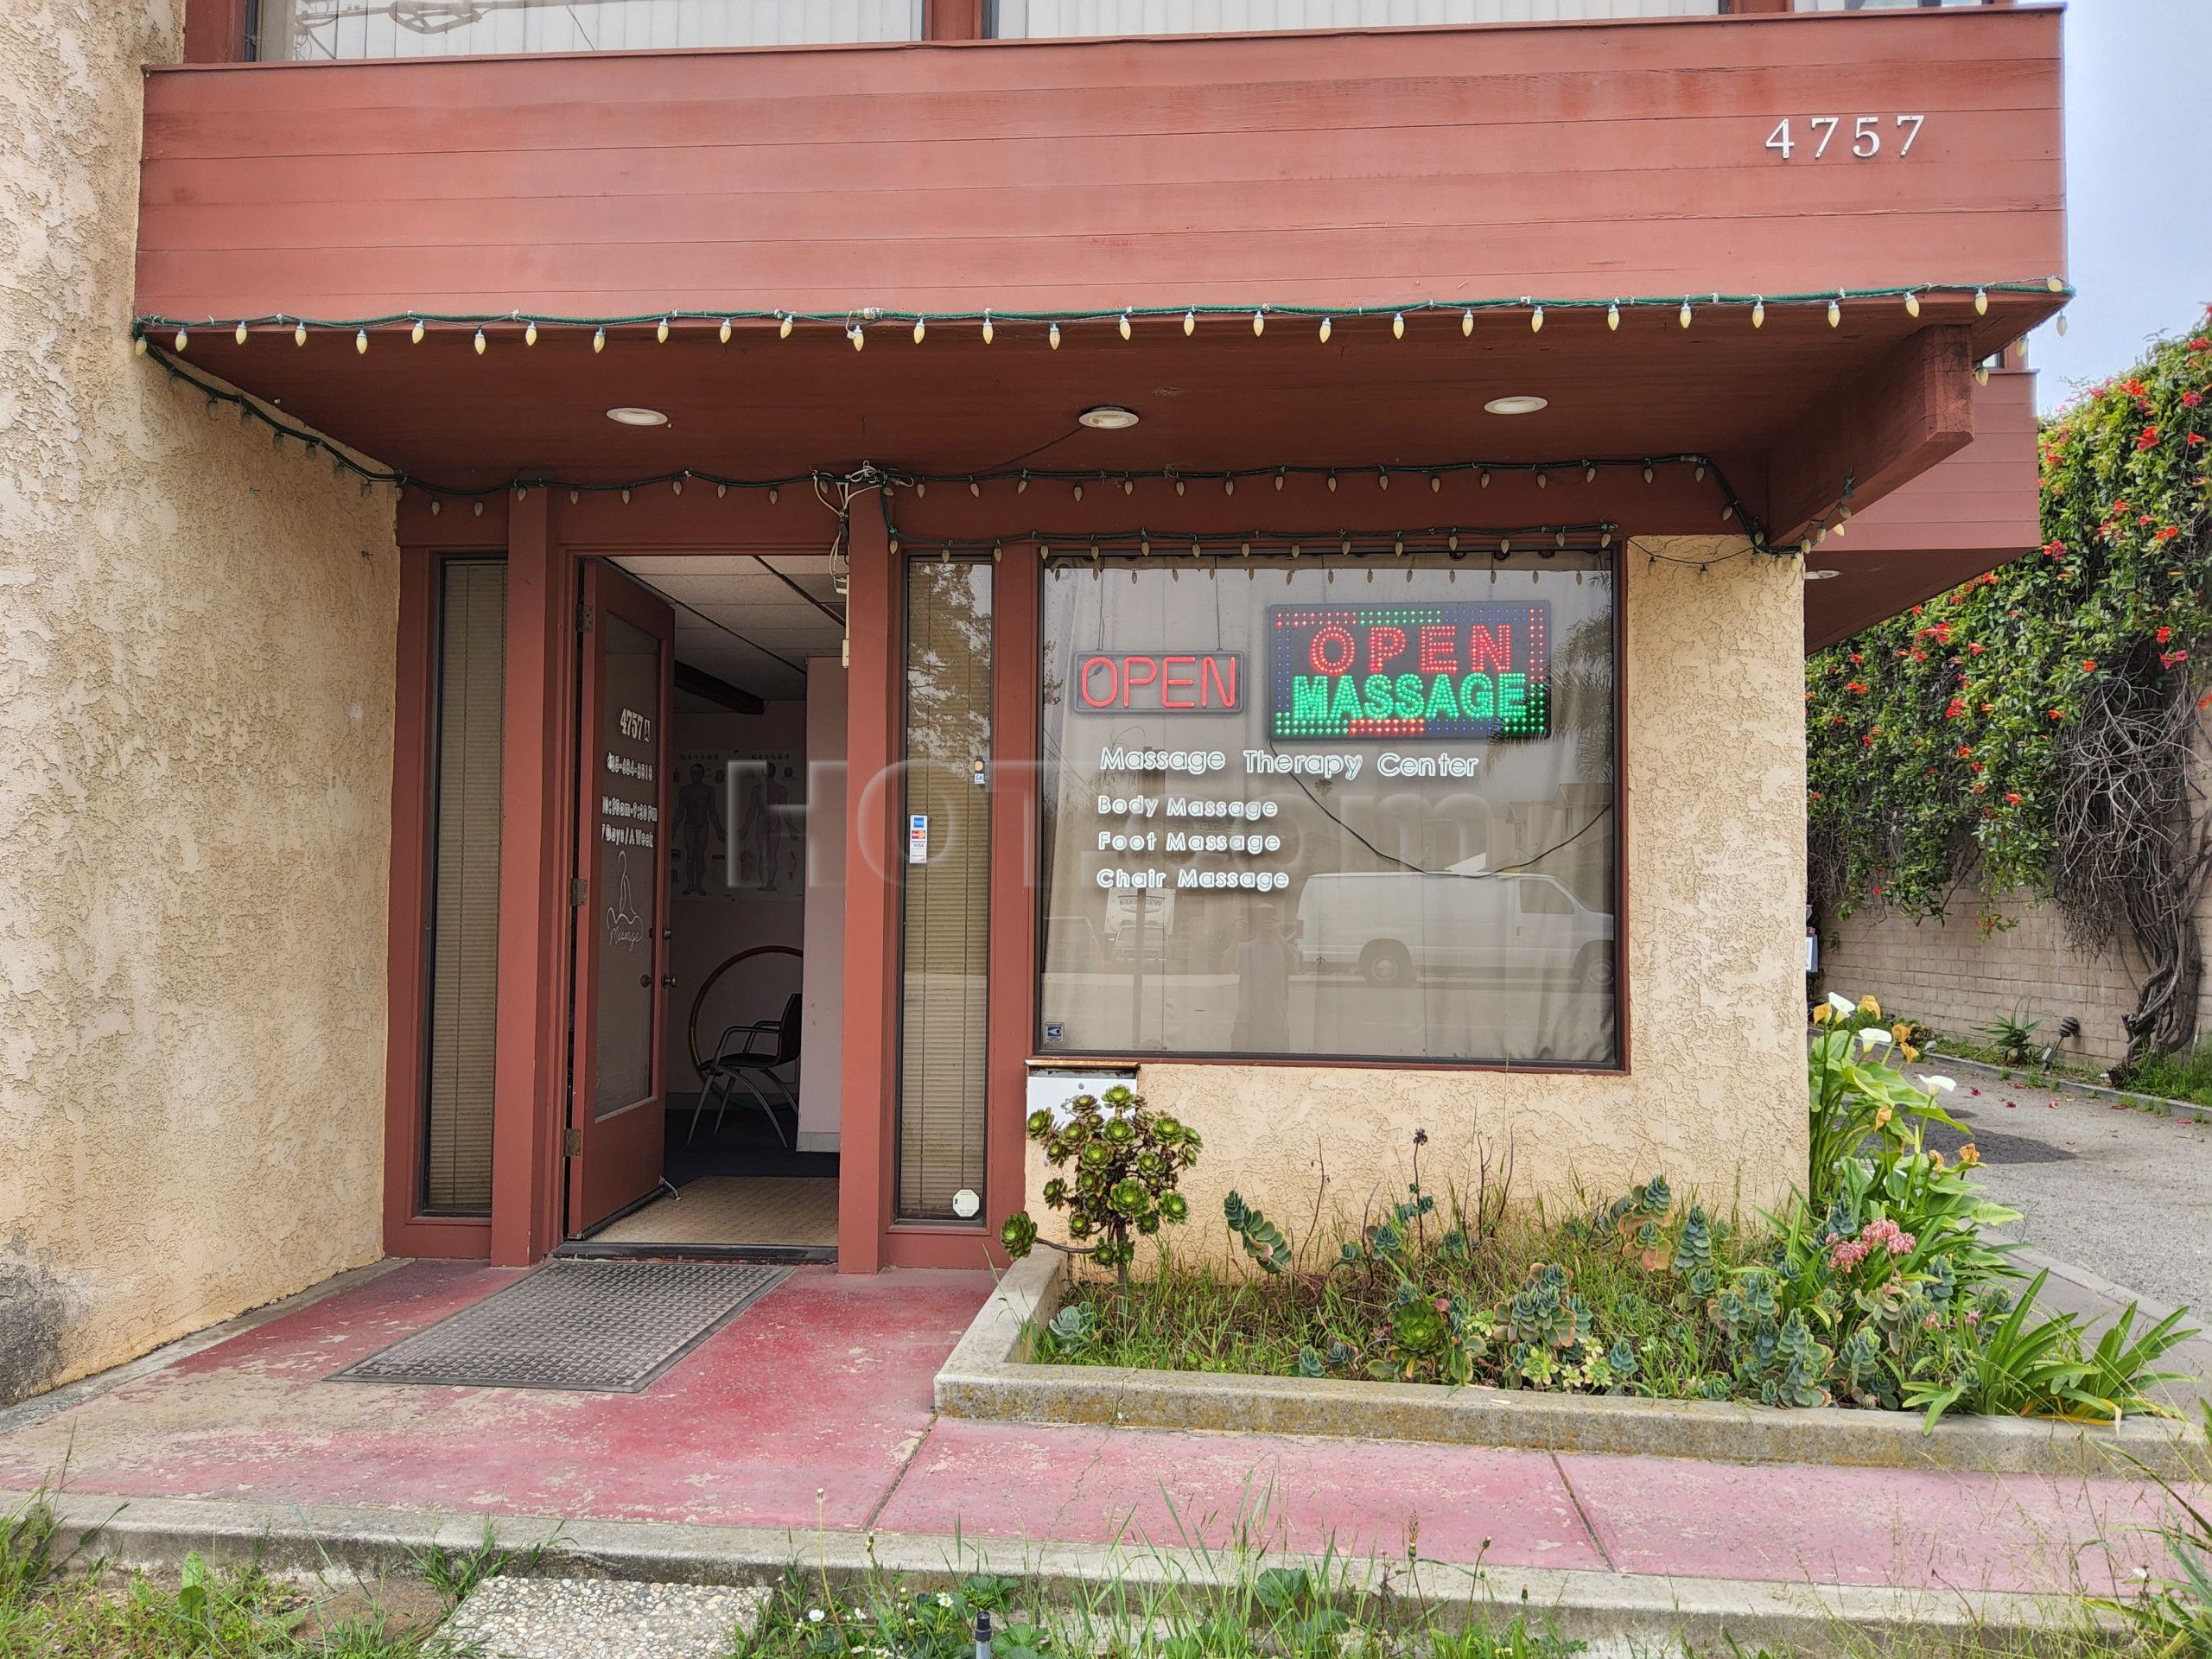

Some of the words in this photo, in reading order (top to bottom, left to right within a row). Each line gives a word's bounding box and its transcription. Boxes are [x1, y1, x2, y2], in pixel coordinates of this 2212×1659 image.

[1765, 115, 1925, 160] 4757
[1310, 625, 1511, 675] OPEN
[1082, 657, 1236, 708] OPEN
[1293, 672, 1527, 719] MASSAGE
[620, 708, 644, 741] 4757
[1100, 747, 1226, 775] Massage
[1243, 749, 1363, 780] Therapy
[1377, 752, 1479, 777] Center
[1098, 795, 1159, 818] Body
[1166, 797, 1278, 821] Massage
[1098, 831, 1156, 851] Foot
[1166, 832, 1281, 855] Massage
[1096, 868, 1166, 888] Chair
[1178, 868, 1290, 892] Massage
